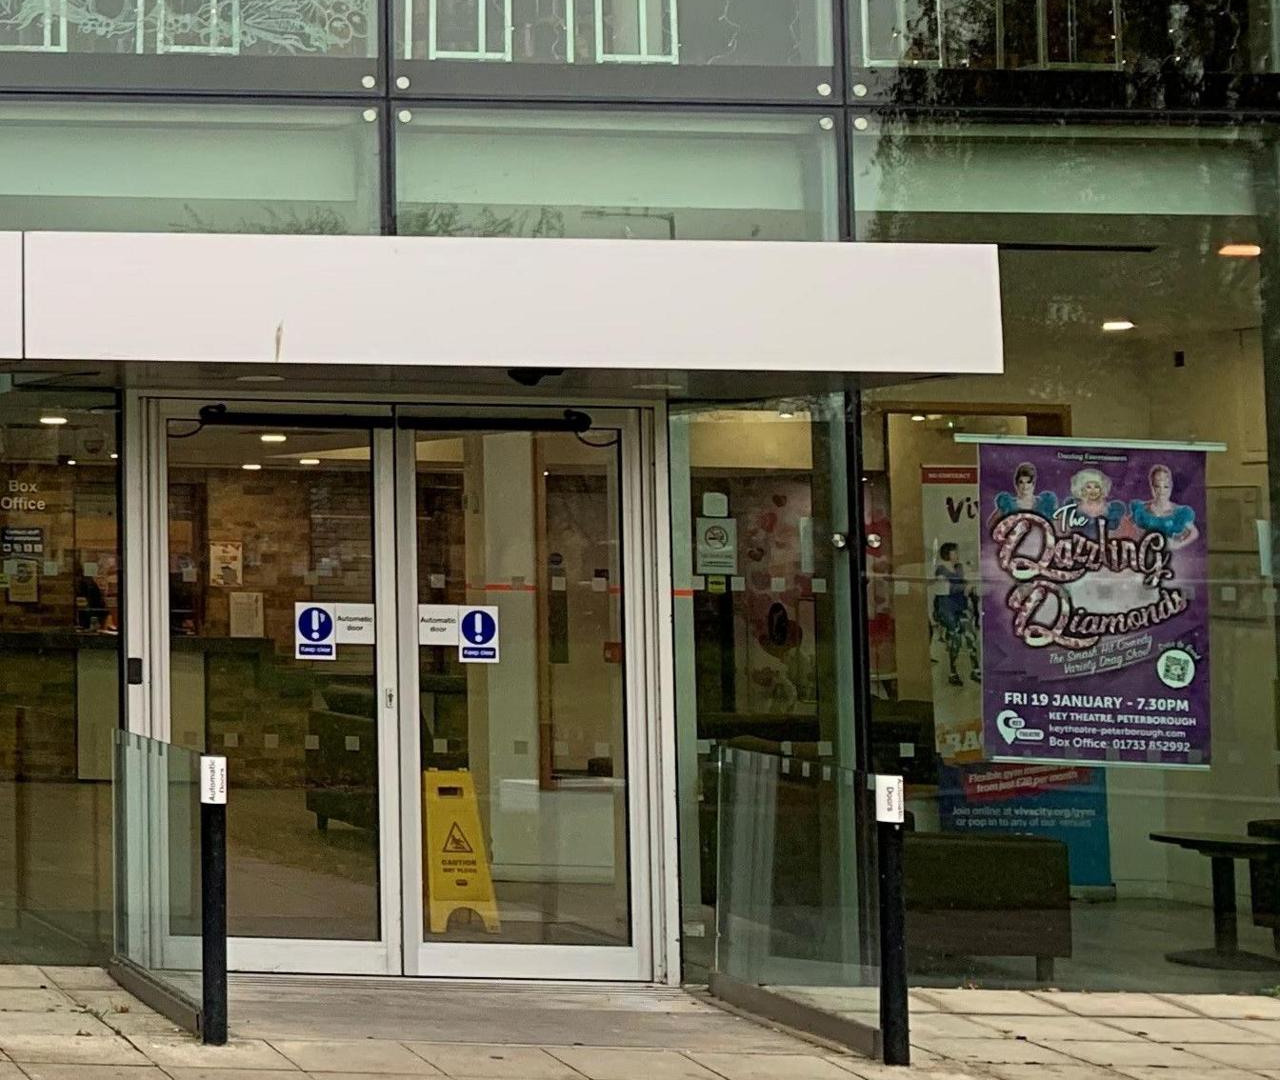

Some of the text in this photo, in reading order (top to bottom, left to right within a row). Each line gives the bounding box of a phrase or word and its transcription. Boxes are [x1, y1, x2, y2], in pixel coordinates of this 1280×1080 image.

[8, 480, 38, 493] Box
[0, 496, 46, 510] Office
[1052, 503, 1089, 533] The
[1006, 579, 1189, 648] Diamonds
[1049, 652, 1065, 664] The
[1066, 646, 1099, 663] Smash
[1100, 643, 1115, 655] Hit
[1116, 633, 1153, 654] Comedy
[1063, 659, 1097, 675] Variety
[1099, 653, 1124, 669] Drag
[1125, 646, 1152, 661] Show
[1004, 692, 1190, 712] FRI 19 JANUARY 7.30PM
[1048, 711, 1197, 726] KEY THEATRE, PETERBOROUGH
[1048, 724, 1187, 738] keytheatre-peterborough.com
[1048, 736, 1070, 749] Box
[1112, 739, 1146, 751] 01733
[1148, 740, 1191, 753] 852992
[952, 806, 971, 816] Join
[972, 806, 1002, 816] online
[1004, 807, 1013, 816] at
[968, 819, 988, 828] pop
[998, 818, 1009, 827] to
[1010, 818, 1028, 828] any
